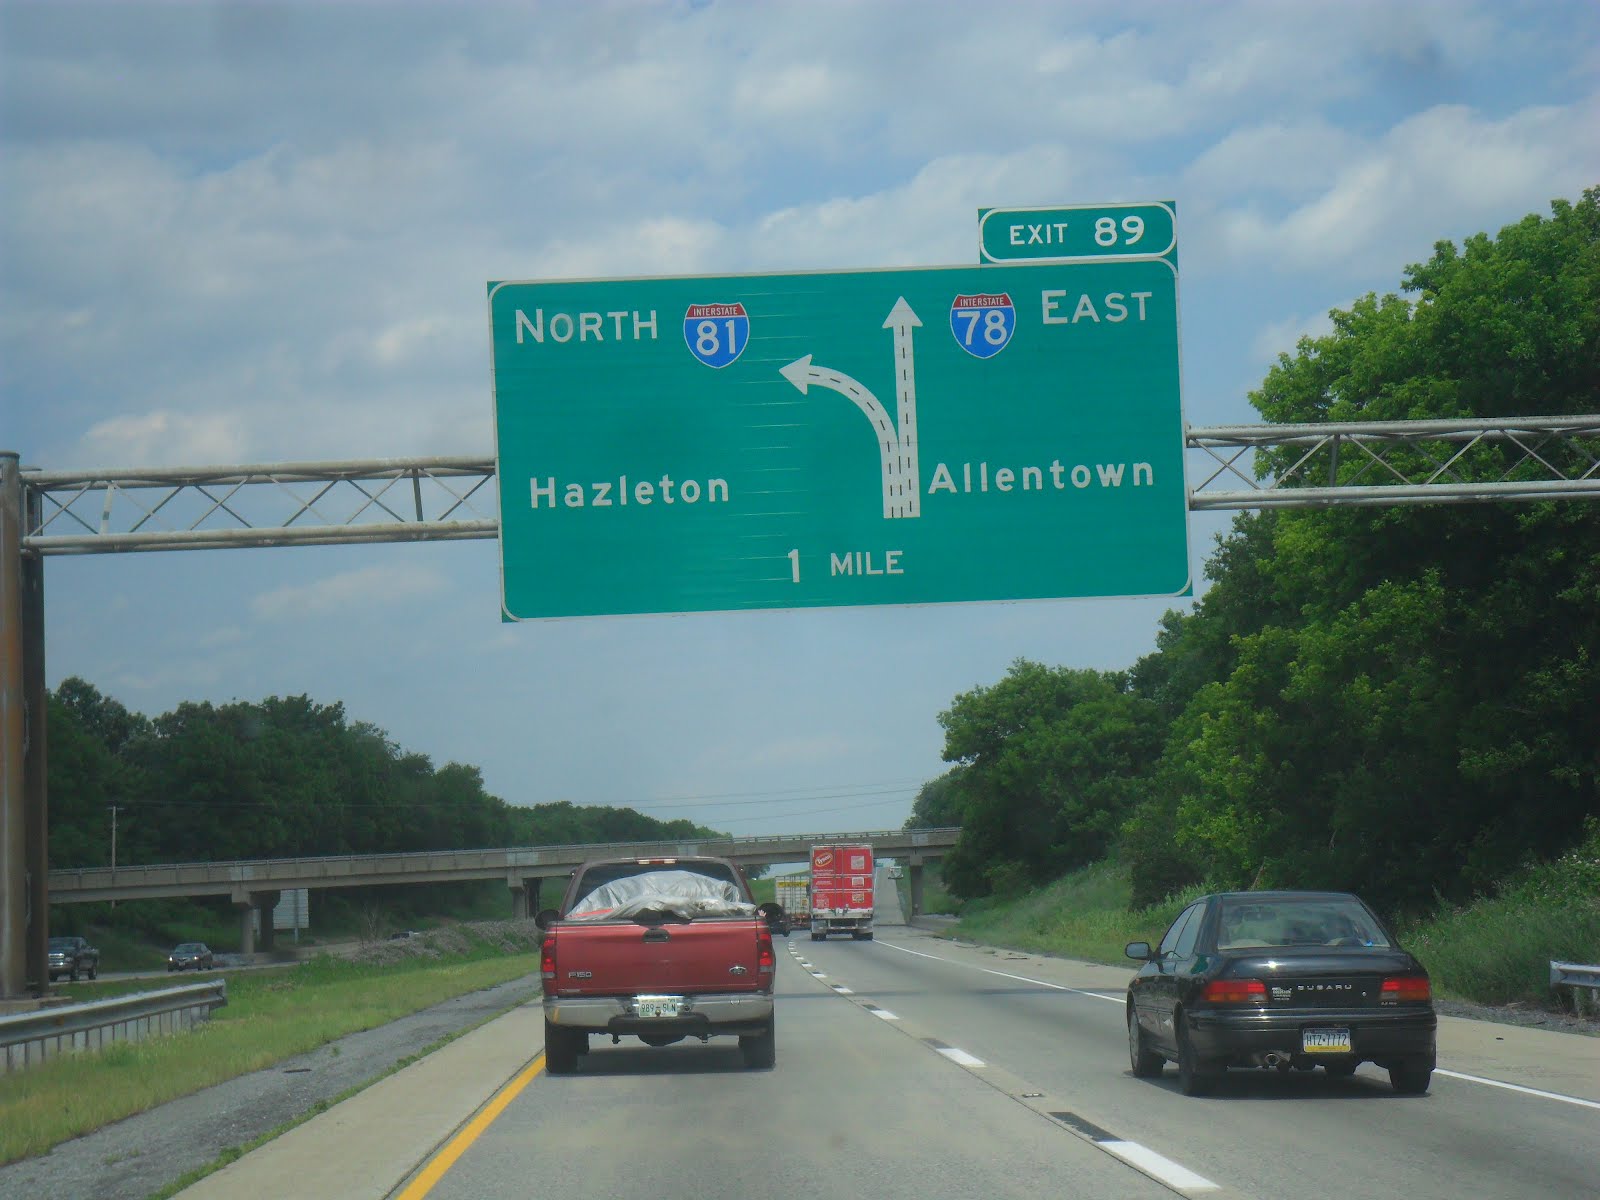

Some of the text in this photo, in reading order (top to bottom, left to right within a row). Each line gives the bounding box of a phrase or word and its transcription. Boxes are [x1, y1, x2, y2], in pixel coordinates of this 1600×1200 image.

[1009, 215, 1145, 247] EXIT 89
[693, 306, 738, 317] INTERSTATE
[960, 296, 1005, 307] INTERSTATE
[1041, 289, 1153, 325] EAST
[515, 308, 658, 344] NORTH
[696, 319, 736, 356] 81
[957, 309, 1008, 346] 78
[529, 473, 730, 509] Hazleton
[927, 459, 1154, 494] Allentown
[787, 548, 905, 583] 1 MILE
